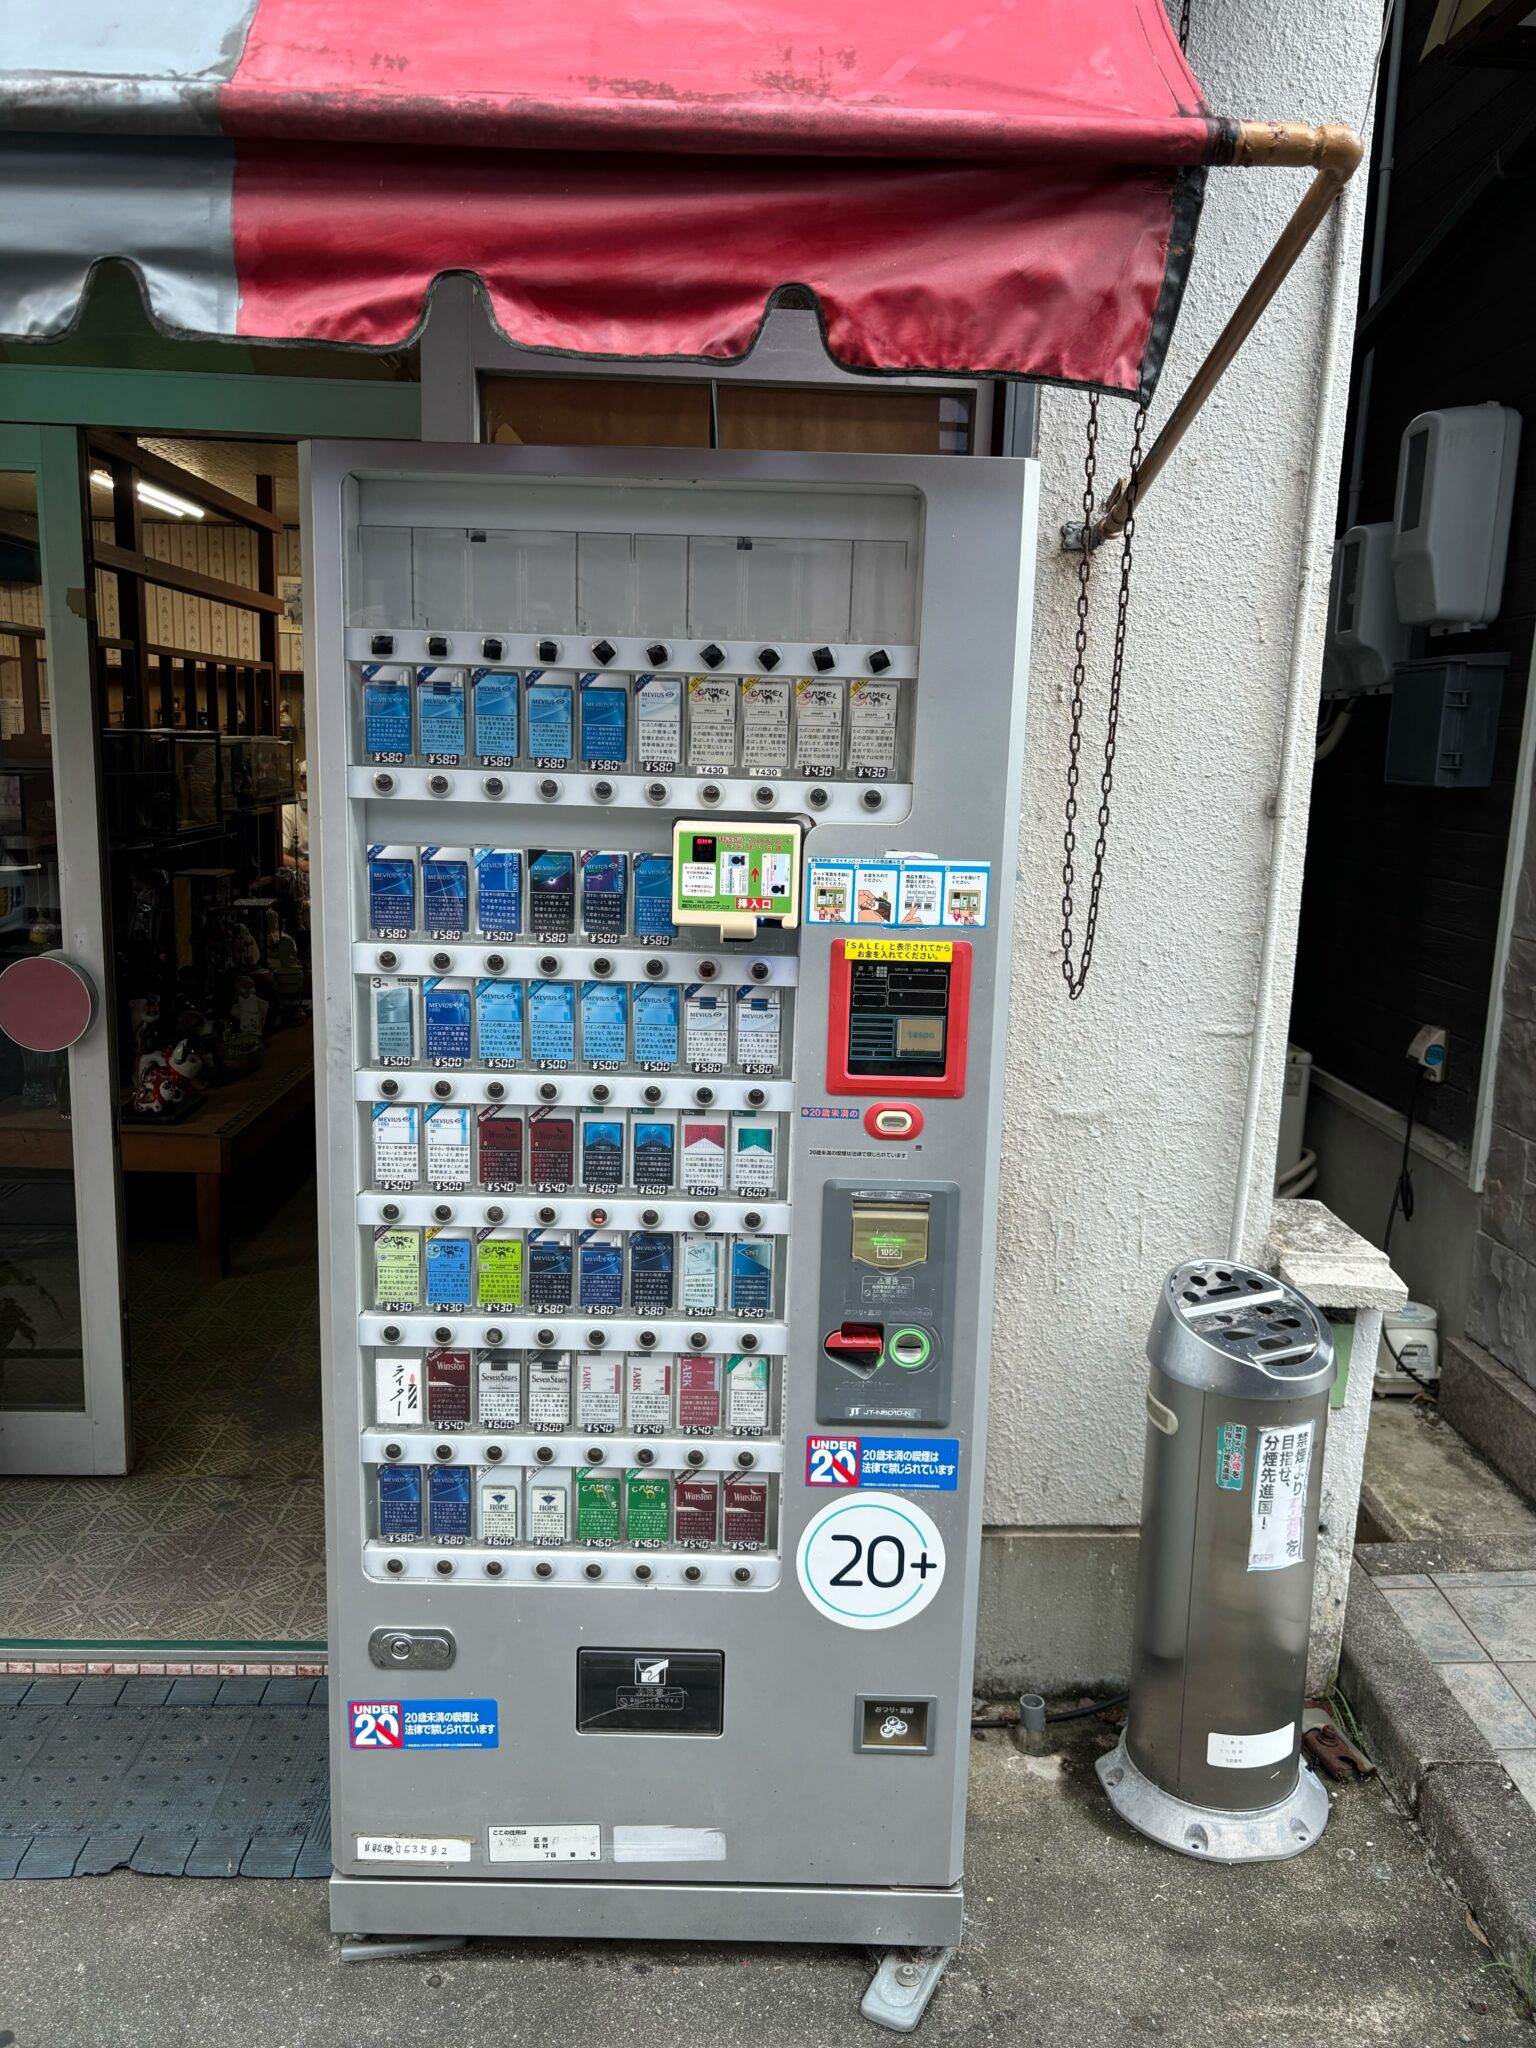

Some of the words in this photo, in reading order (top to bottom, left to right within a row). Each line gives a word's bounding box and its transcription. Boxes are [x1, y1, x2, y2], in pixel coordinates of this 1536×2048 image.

[698, 688, 730, 696] CAMEL
[751, 690, 783, 698] CAMEL
[804, 691, 837, 699] CAMEL
[859, 692, 892, 700] CAMEL
[375, 752, 402, 762] ¥580
[429, 754, 457, 765] ¥580
[483, 756, 511, 767] ¥580
[537, 758, 565, 768] ¥580
[590, 761, 618, 771] ¥580
[645, 762, 673, 772] ¥580
[805, 767, 832, 776] ¥430
[858, 768, 885, 778] ¥430
[738, 899, 771, 909] 挿入口
[380, 930, 407, 939] ¥580
[433, 931, 460, 940] ¥580
[486, 932, 513, 941] ¥500
[539, 934, 566, 942] ¥580
[591, 934, 618, 944] ¥500
[642, 936, 669, 945] ¥580
[846, 941, 950, 952] 「SALE」と表示されてから
[858, 952, 939, 960] お金を入れてください。
[908, 1030, 935, 1040] taspo
[384, 1058, 410, 1066] ¥500
[435, 1059, 462, 1067] ¥500
[488, 1060, 514, 1068] ¥500
[540, 1060, 566, 1069] ¥500
[592, 1062, 618, 1070] ¥500
[644, 1063, 670, 1072] ¥500
[695, 1064, 721, 1073] ¥580
[746, 1065, 771, 1074] ¥580
[385, 1182, 411, 1190] ¥500
[436, 1182, 463, 1191] ¥500
[488, 1183, 514, 1192] ¥540
[539, 1184, 565, 1193] ¥540
[383, 1235, 414, 1244] CAMEL
[433, 1246, 464, 1254] CAMEL
[485, 1246, 516, 1255] CAMEL
[386, 1302, 412, 1312] ¥430
[436, 1303, 463, 1312] ¥430
[487, 1304, 513, 1312] ¥430
[537, 1305, 564, 1314] ¥580
[588, 1306, 614, 1315] ¥580
[638, 1306, 663, 1316] ¥580
[688, 1307, 714, 1316] ¥500
[738, 1308, 764, 1318] ¥520
[437, 1361, 465, 1370] Winston
[482, 1373, 500, 1382] Seven
[501, 1373, 518, 1382] Stars
[682, 1359, 692, 1388] LARK
[532, 1375, 550, 1383] Seven
[550, 1376, 568, 1384] Stars
[582, 1366, 591, 1391] LARK
[633, 1367, 642, 1392] LARK
[390, 1365, 404, 1417] ライター
[849, 1408, 860, 1417] JT
[437, 1421, 464, 1430] ¥540
[488, 1420, 513, 1429] ¥600
[536, 1424, 561, 1432] ¥600
[587, 1424, 612, 1433] ¥540
[636, 1425, 662, 1434] ¥540
[686, 1426, 711, 1435] ¥540
[811, 1440, 857, 1450] UNDER
[862, 1450, 939, 1462] 20歳未満の喫煙は
[1279, 1435, 1294, 1488] 目指せ、
[810, 1450, 856, 1483] 20
[862, 1463, 955, 1476] 法律で禁じられています
[1258, 1435, 1279, 1530] 分煙先進国！
[582, 1484, 615, 1492] CAMEL
[632, 1485, 665, 1493] CAMEL
[685, 1492, 712, 1501] Winston
[734, 1492, 762, 1502] Winston
[389, 1534, 414, 1543] ¥580
[438, 1536, 464, 1545] ¥580
[488, 1537, 513, 1546] ¥600
[537, 1537, 561, 1546] ¥600
[586, 1539, 611, 1547] ¥460
[634, 1539, 660, 1548] ¥460
[683, 1540, 708, 1549] ¥540
[732, 1541, 757, 1550] ¥540
[830, 1534, 937, 1588] 20+
[353, 1705, 398, 1714] UNDER
[405, 1712, 479, 1723] 20歳未満の喫煙は
[355, 1714, 399, 1746] 20
[405, 1724, 495, 1735] 法律で禁じられています
